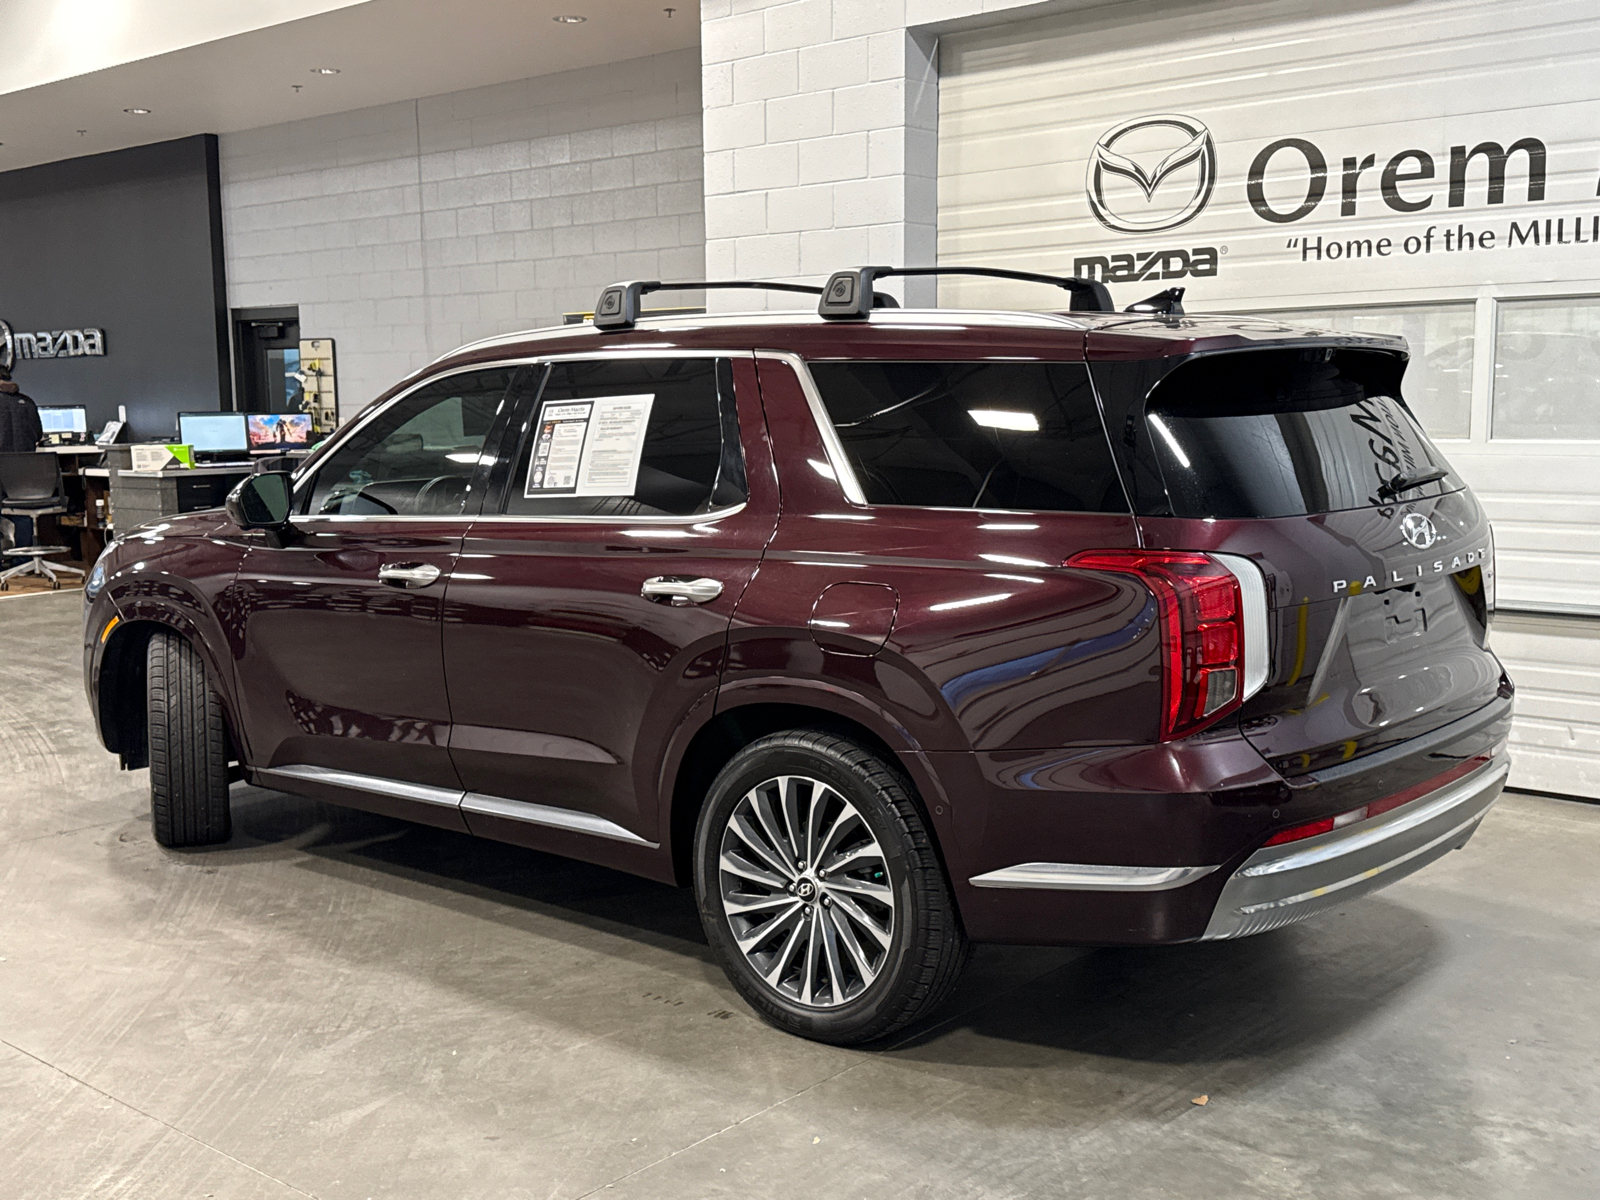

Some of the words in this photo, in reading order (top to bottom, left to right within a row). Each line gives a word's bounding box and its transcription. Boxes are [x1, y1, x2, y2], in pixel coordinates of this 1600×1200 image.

[1247, 138, 1546, 223] Orem
[1403, 226, 1437, 254] of
[1443, 224, 1496, 252] the
[1507, 215, 1600, 248] MILLI
[14, 328, 105, 359] mazda
[1333, 548, 1485, 593] PALISADE
